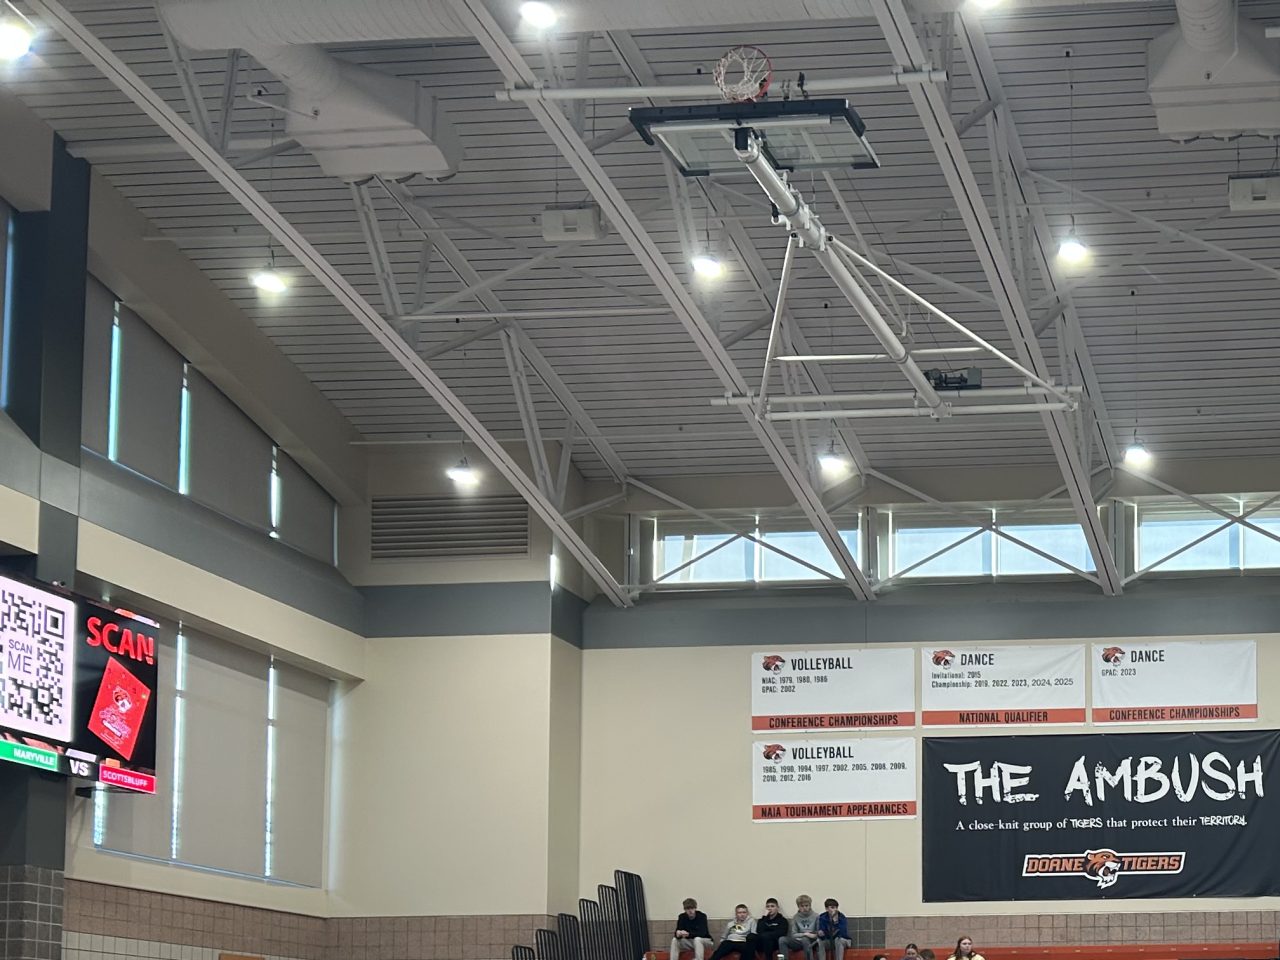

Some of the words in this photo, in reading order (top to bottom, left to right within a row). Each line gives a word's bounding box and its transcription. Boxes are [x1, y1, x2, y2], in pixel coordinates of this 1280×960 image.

[8, 639, 33, 655] SCAN
[8, 652, 32, 674] ME
[961, 653, 994, 666] DANCE
[1131, 650, 1165, 663] DANCE
[791, 657, 853, 670] VOLLEYBALL
[1120, 668, 1136, 676] 2023
[1054, 678, 1073, 686] 2025
[959, 712, 1000, 723] NATIONAL
[1004, 712, 1048, 723] QUALIFIER
[1110, 709, 1165, 720] CONFERENCE
[1169, 707, 1240, 718] CHAMPIONSHIPS
[769, 716, 825, 728] CONFERENCE
[829, 715, 898, 727] CHAMPIONSHIPS
[13, 748, 54, 765] MARYVILLE
[792, 746, 854, 760] VOLLEYBALL
[69, 759, 89, 776] VS
[103, 770, 148, 787] SCOTTSBLUFF
[943, 761, 1039, 805] THE
[1064, 751, 1264, 806] AMBUSH
[761, 806, 781, 817] NAIA
[785, 805, 842, 817] TOURNAMENT
[847, 804, 908, 815] APPEARANCES
[956, 820, 965, 830] A
[968, 819, 1019, 830] close-knit
[1023, 821, 1053, 831] group
[1056, 818, 1068, 829] of
[1070, 817, 1103, 828] TIGERS
[1106, 817, 1127, 828] that
[1131, 818, 1168, 829] protect
[1172, 816, 1197, 826] their
[1027, 857, 1085, 872] DOANE
[1122, 856, 1180, 870] TIGERS
